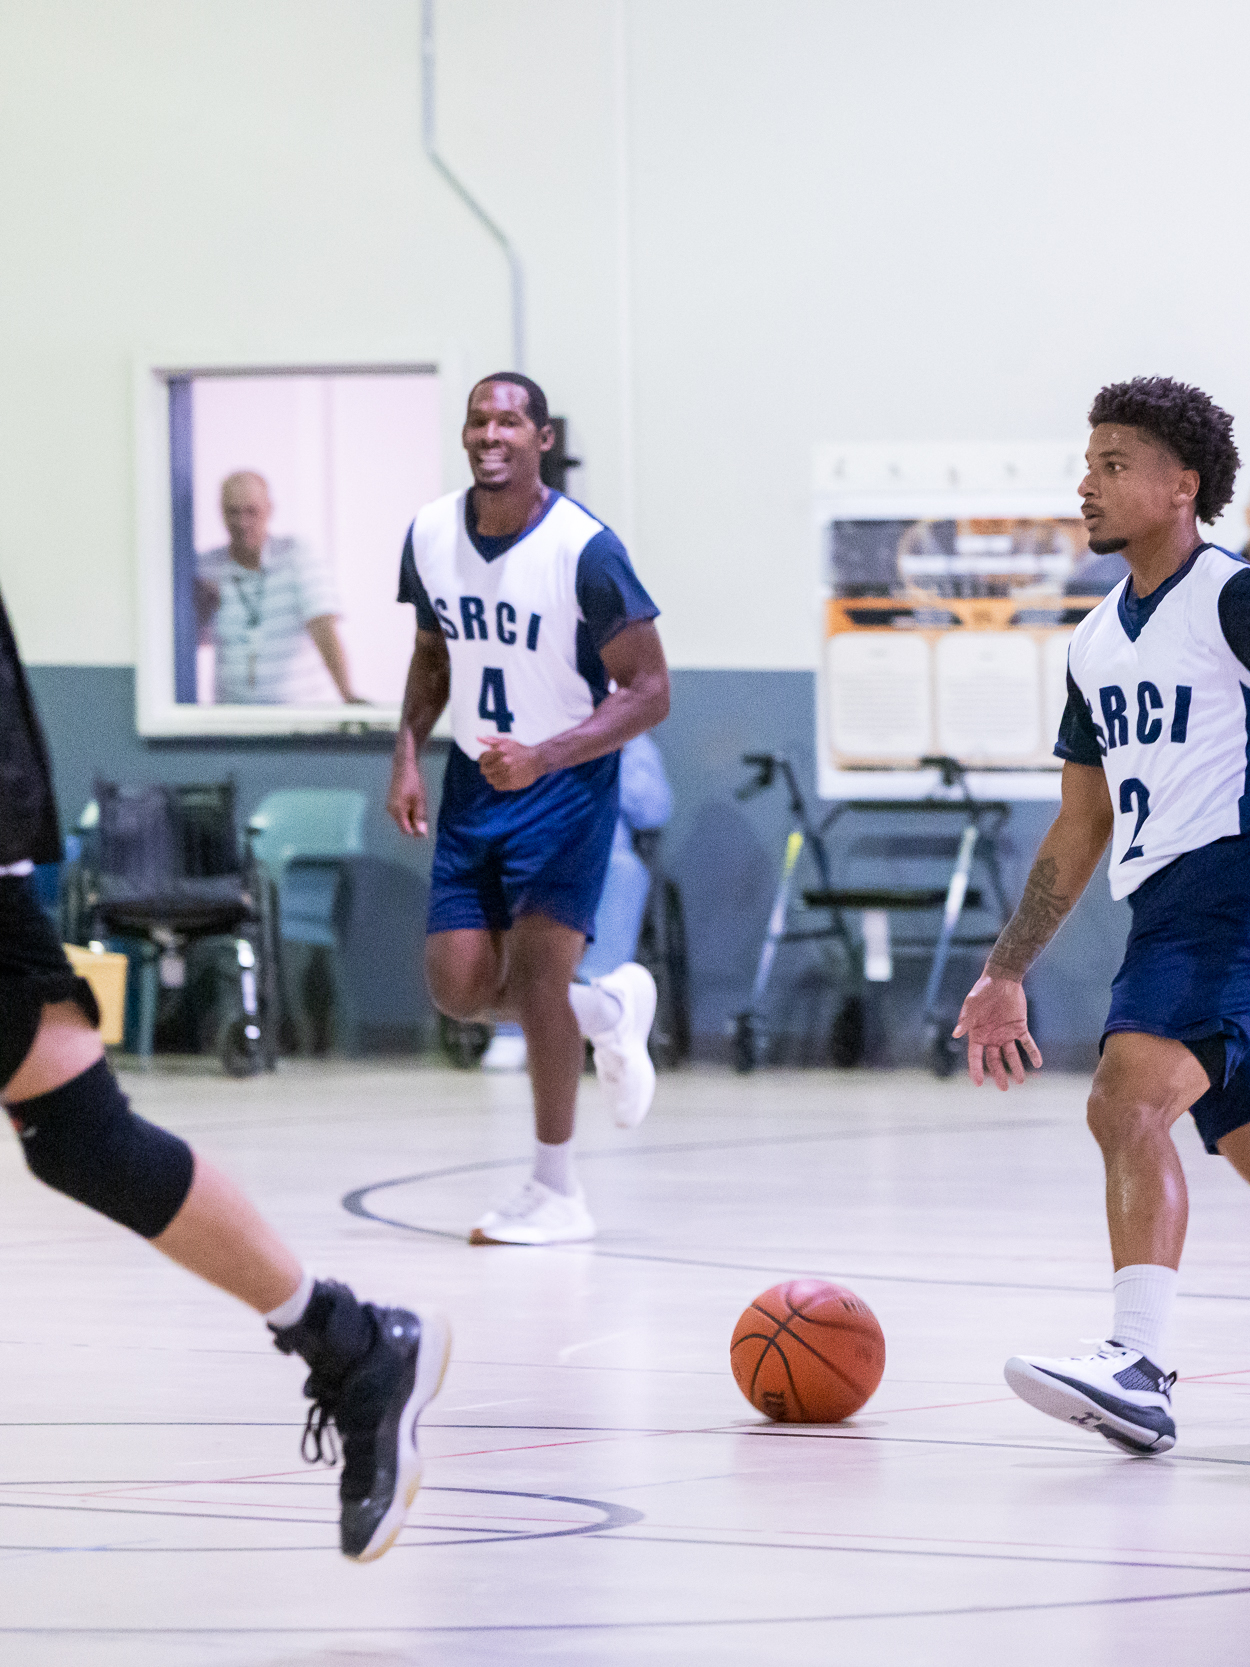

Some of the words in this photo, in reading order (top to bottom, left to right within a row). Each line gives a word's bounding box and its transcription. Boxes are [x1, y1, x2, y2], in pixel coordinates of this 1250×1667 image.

[435, 596, 541, 652] SRCI
[478, 666, 514, 733] 4
[1119, 777, 1151, 865] 2
